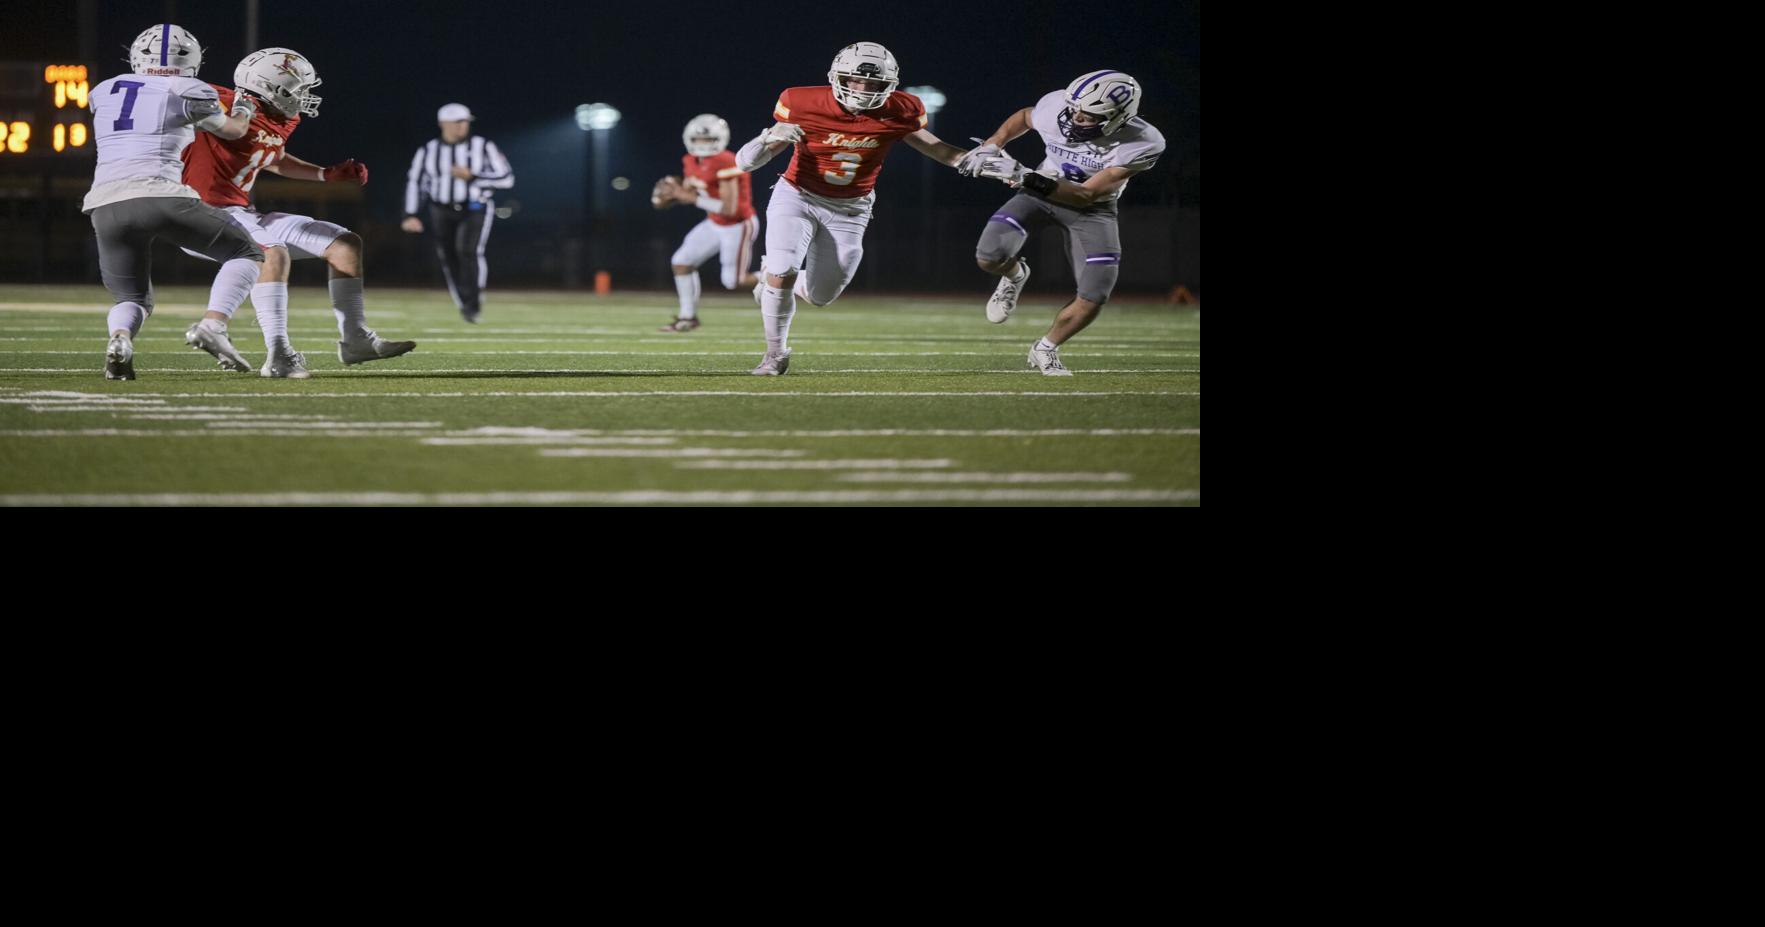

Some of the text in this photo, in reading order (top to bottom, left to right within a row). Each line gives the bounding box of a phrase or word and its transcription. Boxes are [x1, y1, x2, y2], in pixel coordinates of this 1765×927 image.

[147, 67, 181, 75] Riddell
[54, 80, 89, 109] 14
[110, 80, 146, 131] 7
[1106, 85, 1131, 107] B
[824, 151, 863, 186] 3
[1080, 156, 1105, 170] HIGH
